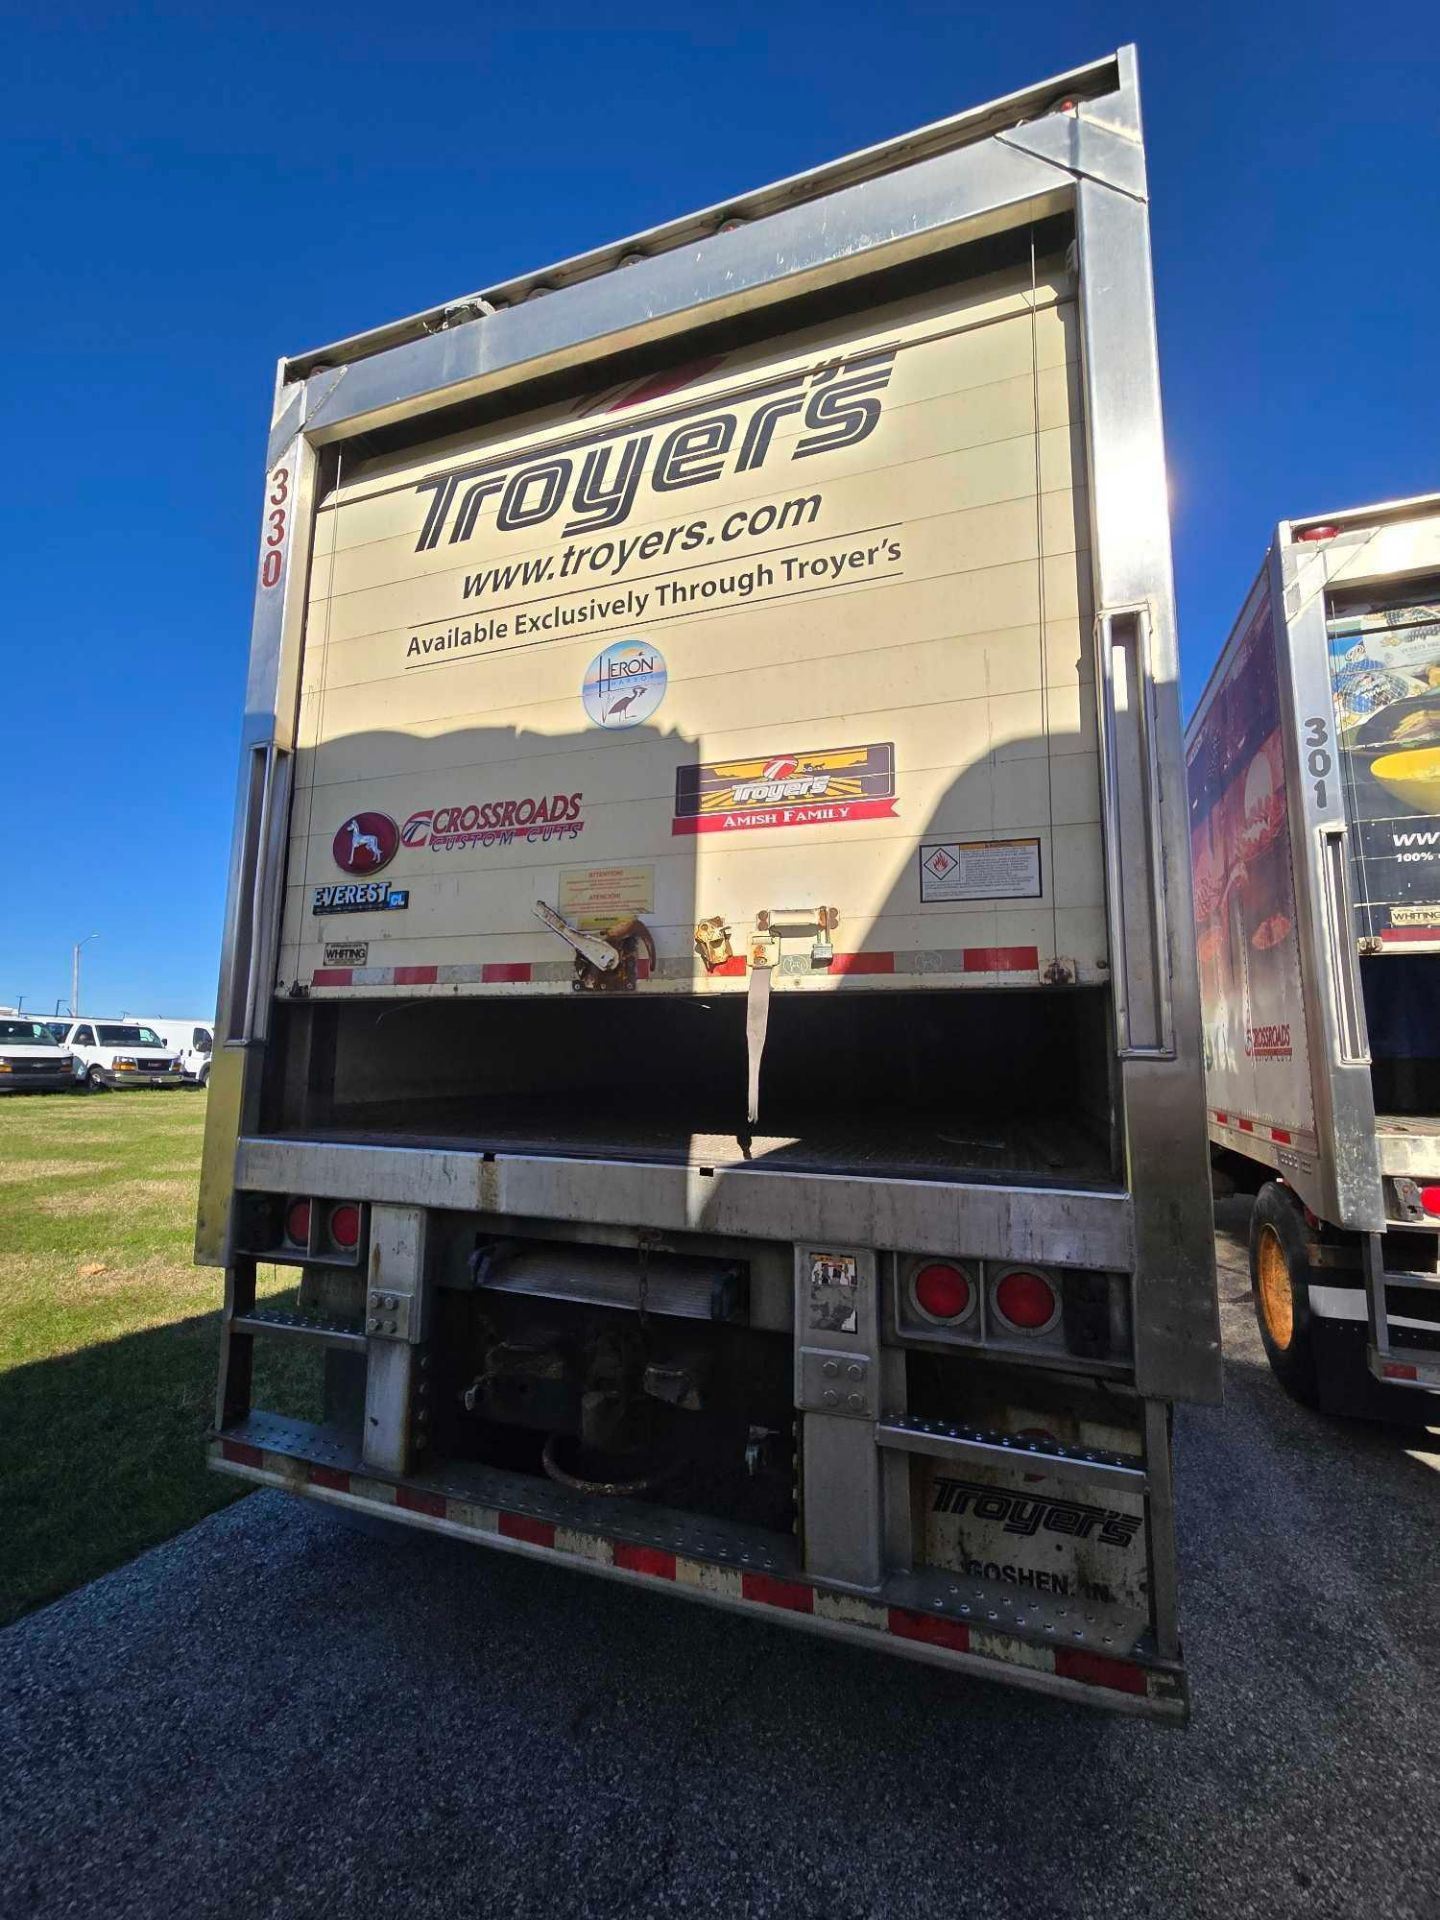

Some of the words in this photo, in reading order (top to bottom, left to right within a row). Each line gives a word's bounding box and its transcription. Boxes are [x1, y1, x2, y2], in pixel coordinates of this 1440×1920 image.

[413, 342, 901, 553] Troyer's
[262, 468, 289, 587] 330
[462, 494, 822, 600] www.troyers.com
[407, 618, 508, 657] Available
[515, 591, 650, 636] Exclusively
[655, 563, 774, 608] Through
[781, 539, 902, 584] Troyer's
[596, 656, 654, 697] HERON
[1304, 718, 1331, 809] 301
[432, 793, 583, 834] CROSSROADS
[723, 814, 777, 828] AMISH
[783, 807, 850, 824] FAMILY
[431, 832, 515, 853] CUSTOM
[527, 823, 582, 844] CUTS
[1396, 852, 1434, 863] 100%
[313, 882, 390, 907] EVEREST
[390, 894, 405, 906] CL
[326, 948, 366, 959] WHITING
[933, 1476, 1144, 1548] Troyer's
